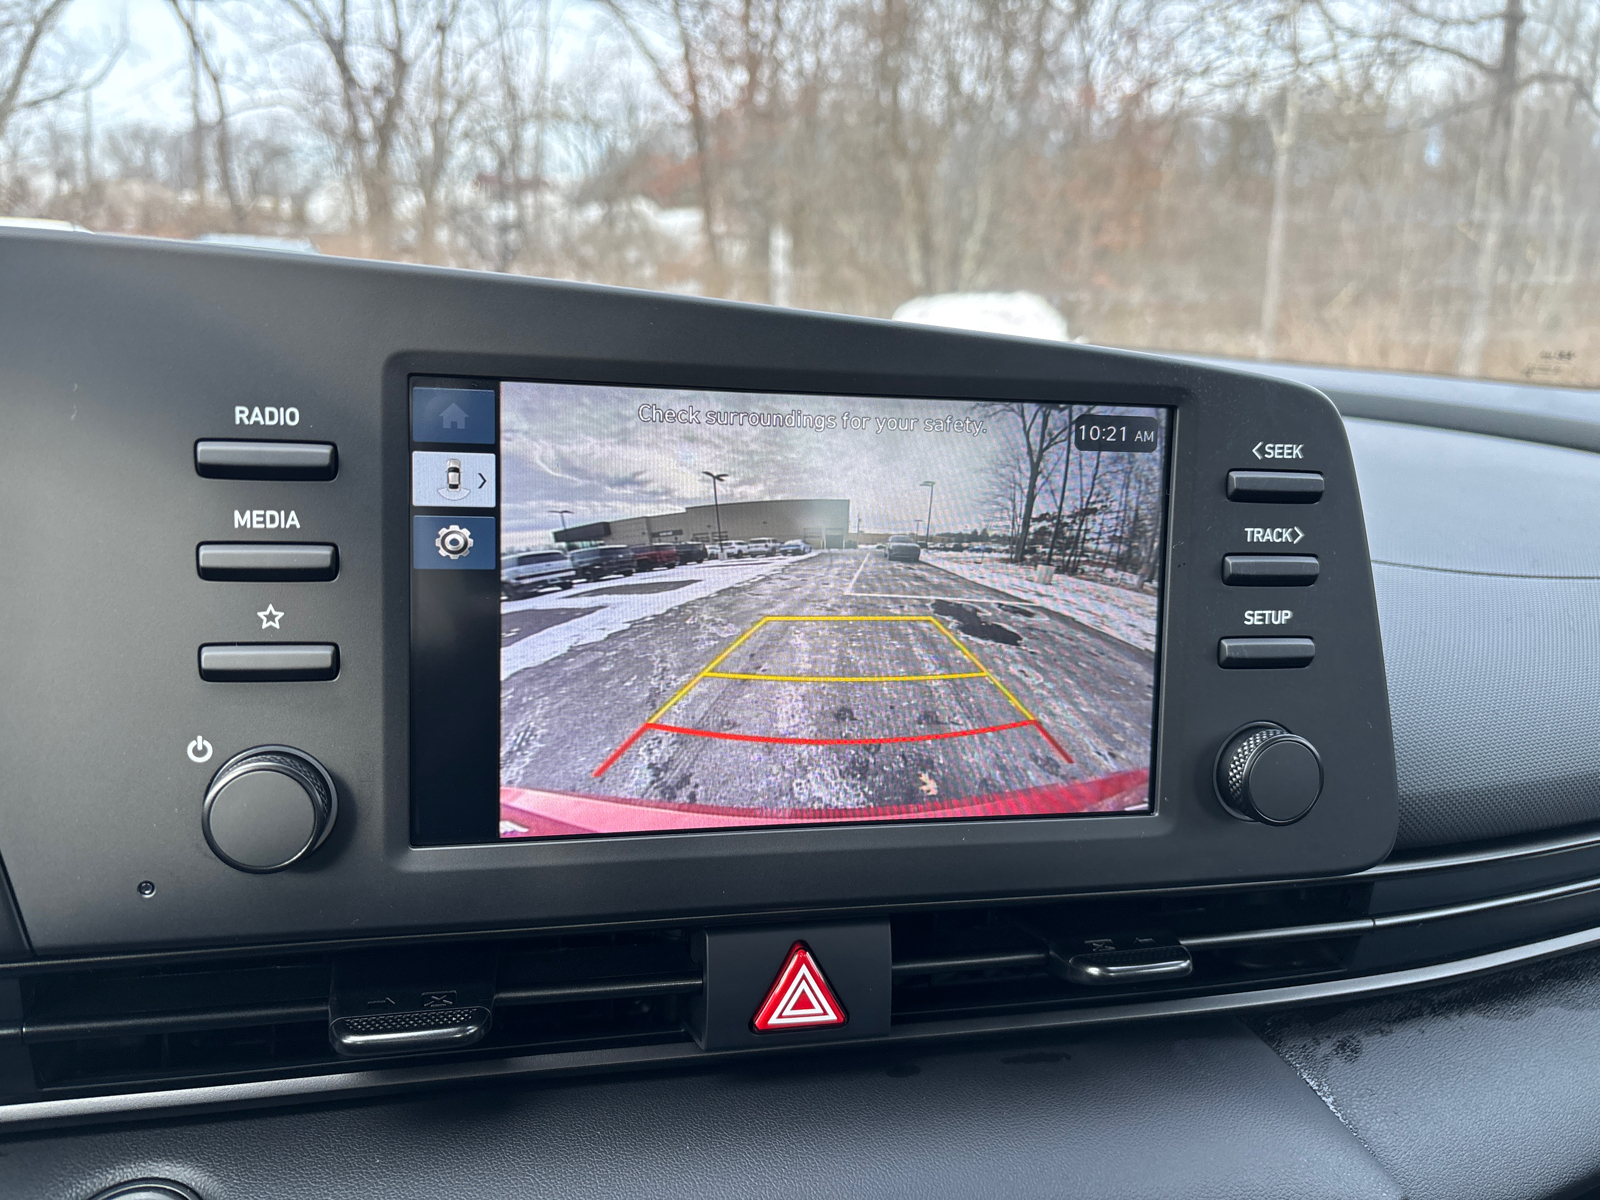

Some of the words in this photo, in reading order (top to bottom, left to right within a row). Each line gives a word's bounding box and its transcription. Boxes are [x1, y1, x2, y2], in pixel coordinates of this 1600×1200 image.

[234, 405, 300, 426] RADIO
[637, 403, 701, 425] Check
[704, 409, 837, 431] surroundings
[841, 412, 871, 430] for
[875, 416, 919, 434] your
[923, 416, 988, 435] safety.
[1077, 424, 1128, 443] 10:21
[1134, 431, 1155, 444] AM
[1264, 443, 1303, 459] SEEK
[233, 509, 301, 529] MEDIA
[1244, 527, 1293, 543] TRACK
[1243, 609, 1293, 625] SETUP
